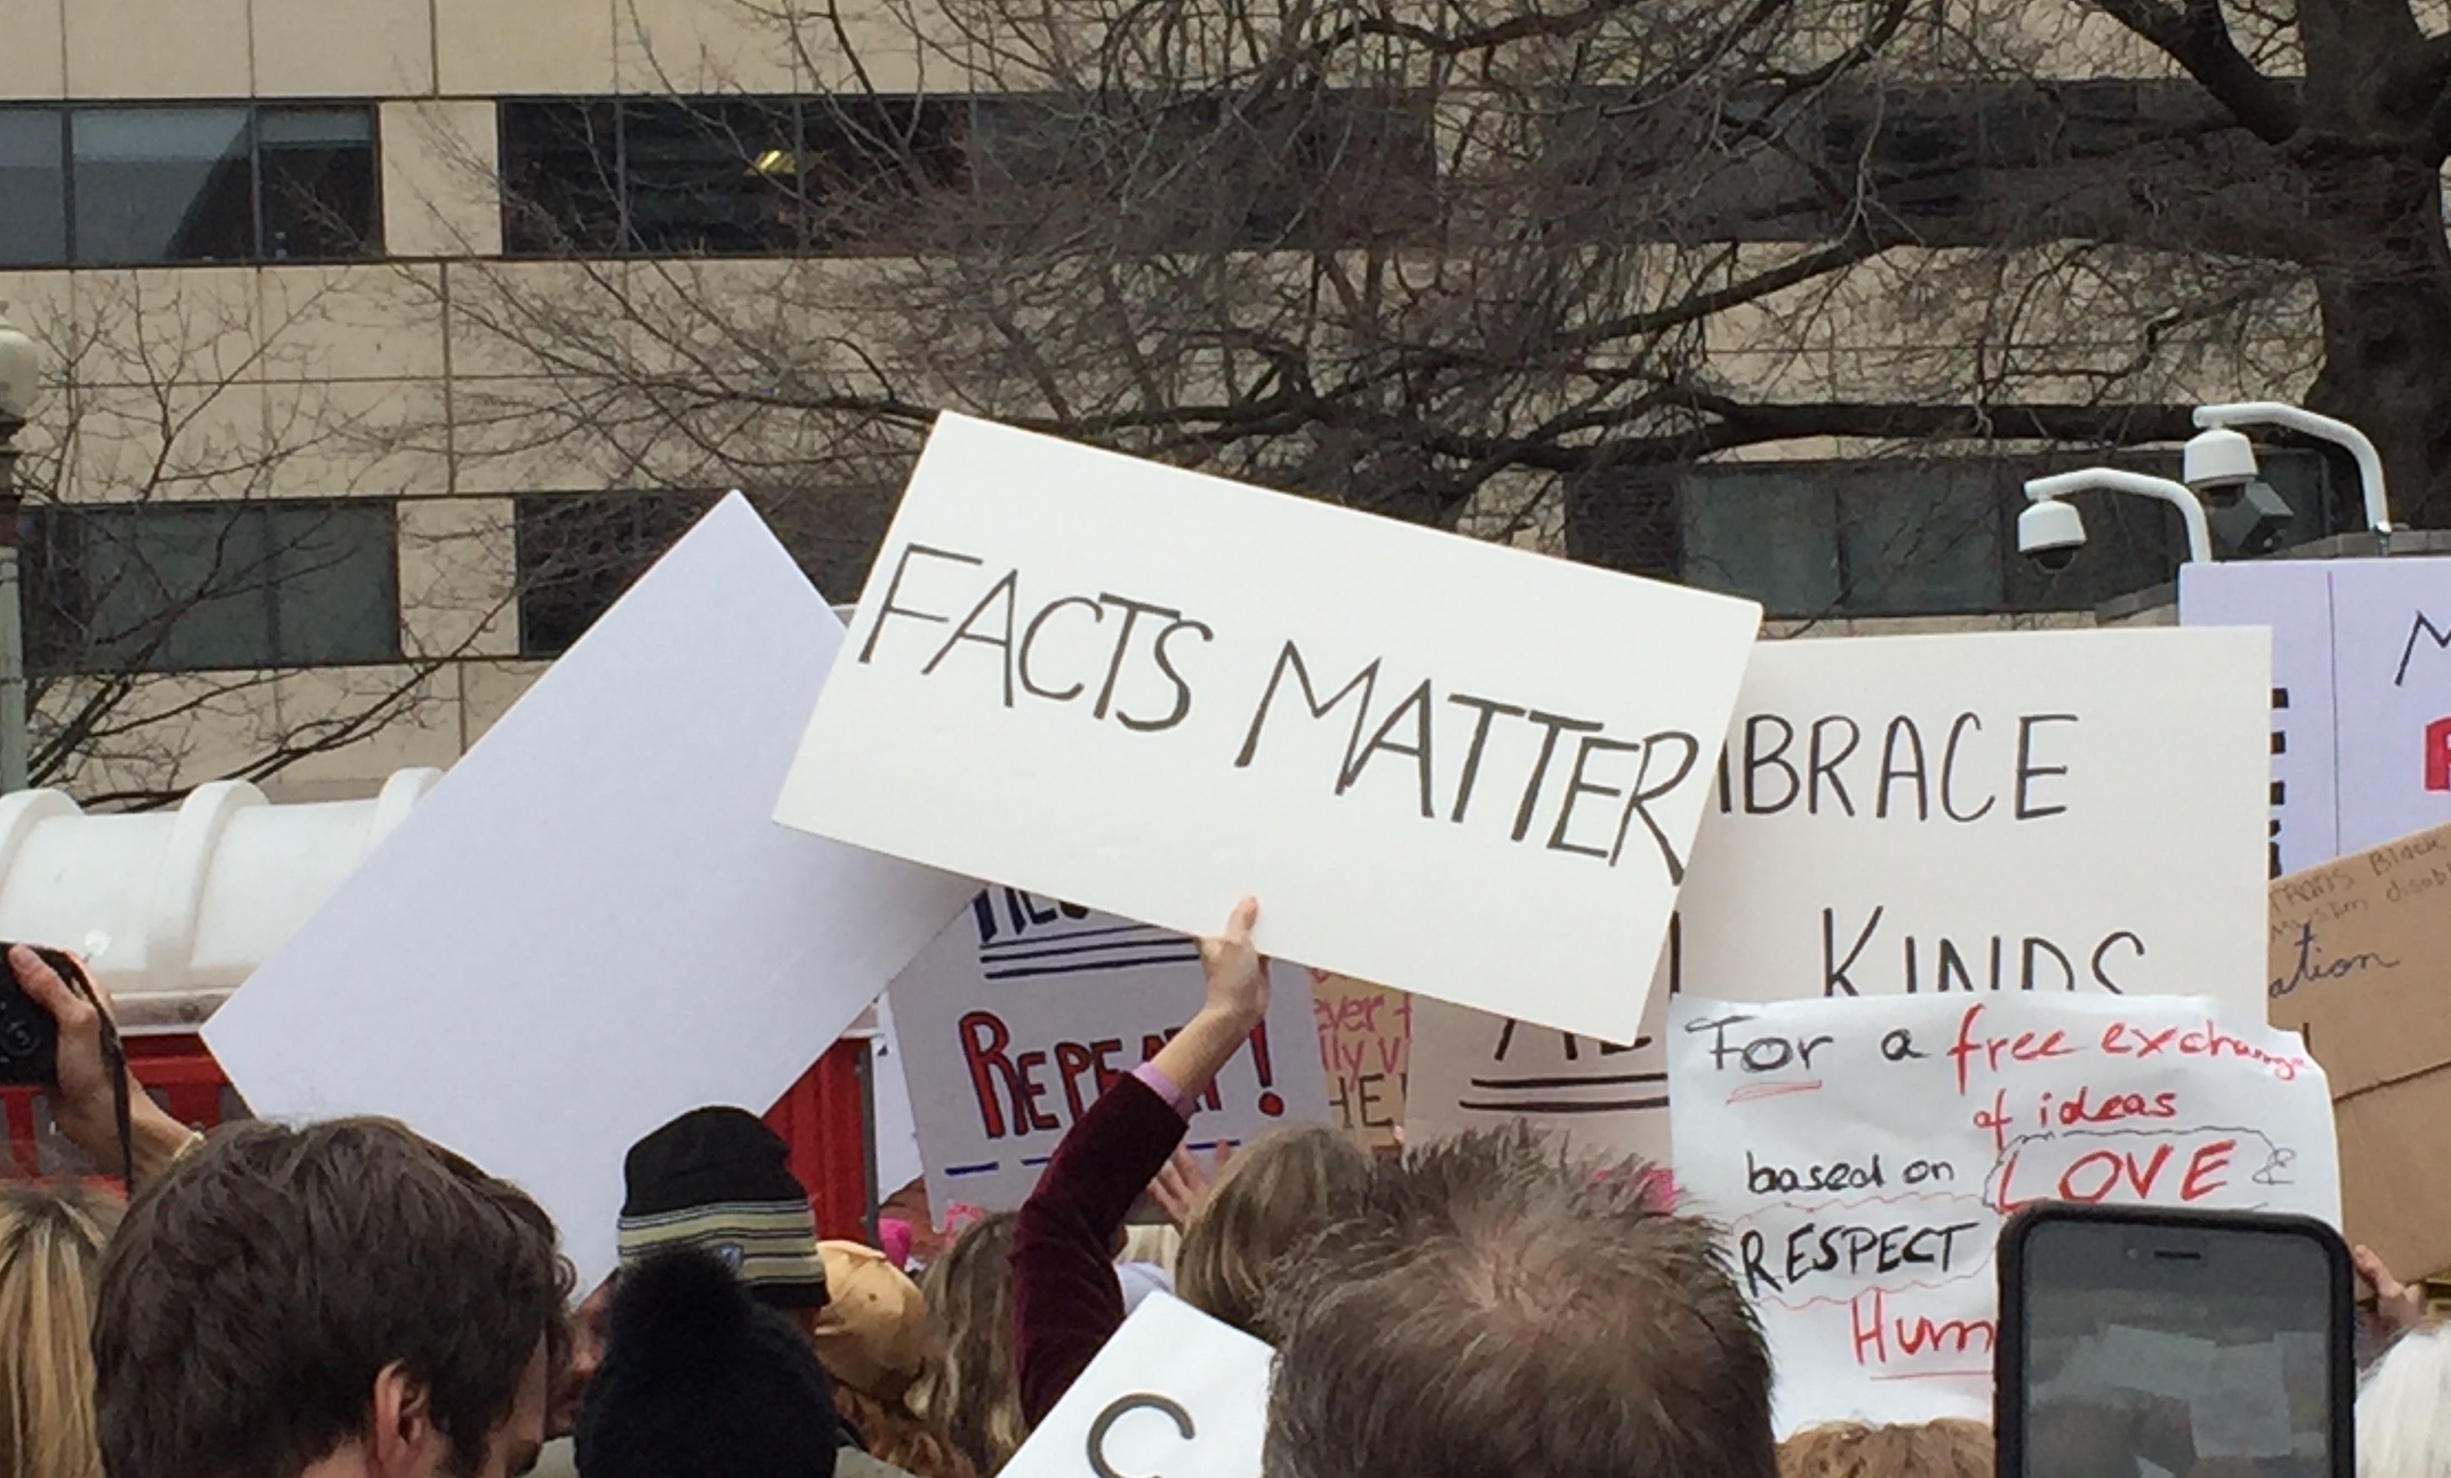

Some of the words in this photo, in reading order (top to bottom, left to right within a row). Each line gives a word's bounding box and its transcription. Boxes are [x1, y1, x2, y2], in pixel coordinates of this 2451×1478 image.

[858, 542, 1214, 732] FACTS
[1233, 639, 1700, 885] MATTER
[1822, 905, 2146, 998] KINDS
[1685, 1014, 1833, 1073] For
[1880, 1030, 1932, 1063] a
[1944, 1003, 2088, 1096] free
[2038, 1085, 2178, 1129] ideas
[1746, 1150, 1886, 1192] based
[1902, 1159, 1955, 1184] on
[1995, 1139, 2237, 1213] LOVE
[1739, 1221, 1980, 1299] RESPECT
[1851, 1288, 1998, 1366] Hum
